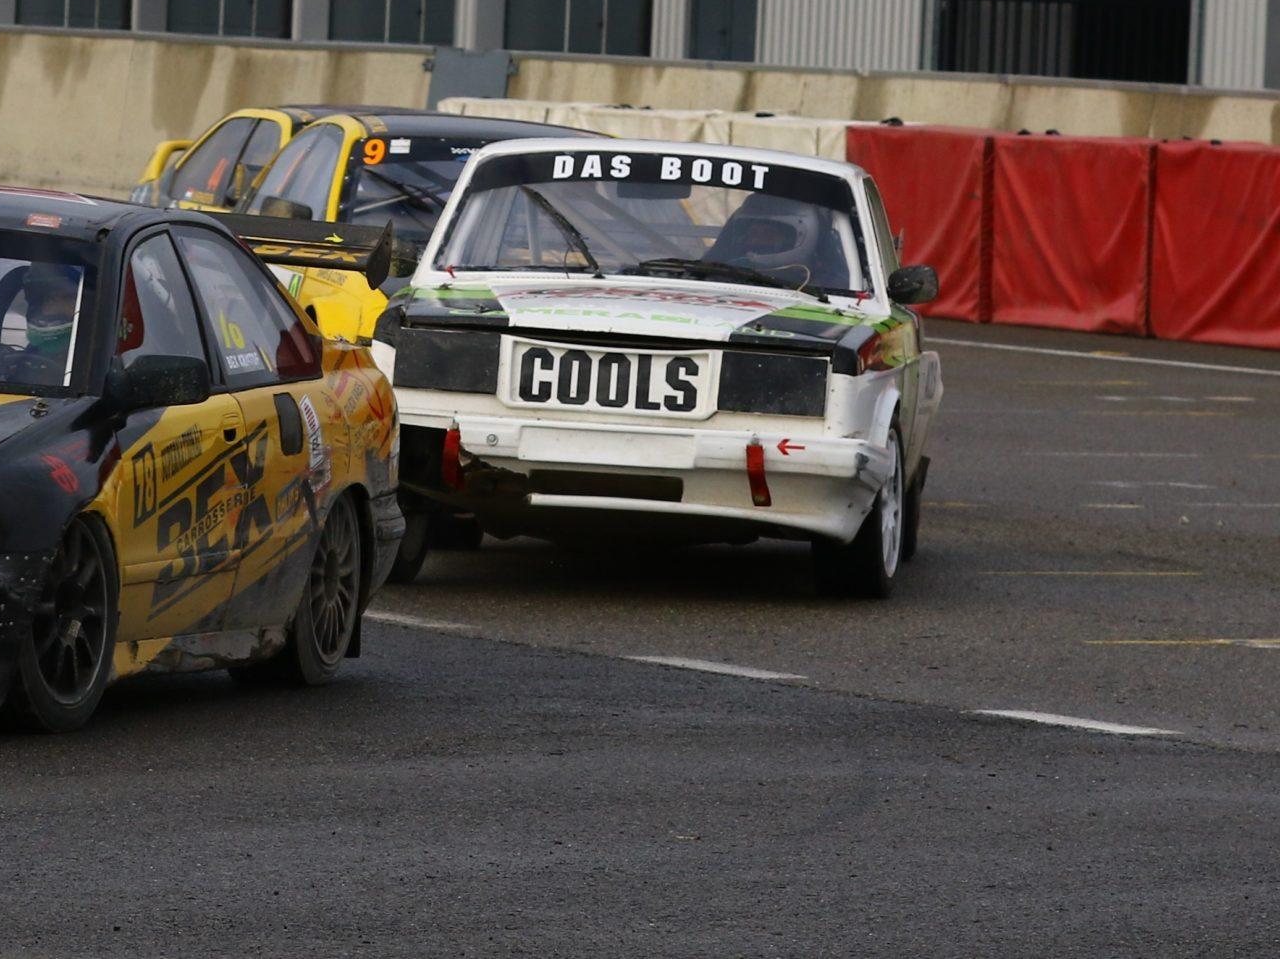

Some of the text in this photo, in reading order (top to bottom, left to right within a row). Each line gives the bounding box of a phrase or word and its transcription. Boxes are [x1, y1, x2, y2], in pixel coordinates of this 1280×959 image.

[363, 138, 386, 166] 9
[553, 153, 770, 190] DAS BOOT
[520, 347, 700, 413] COOLS
[176, 487, 257, 557] CARROSSERIE
